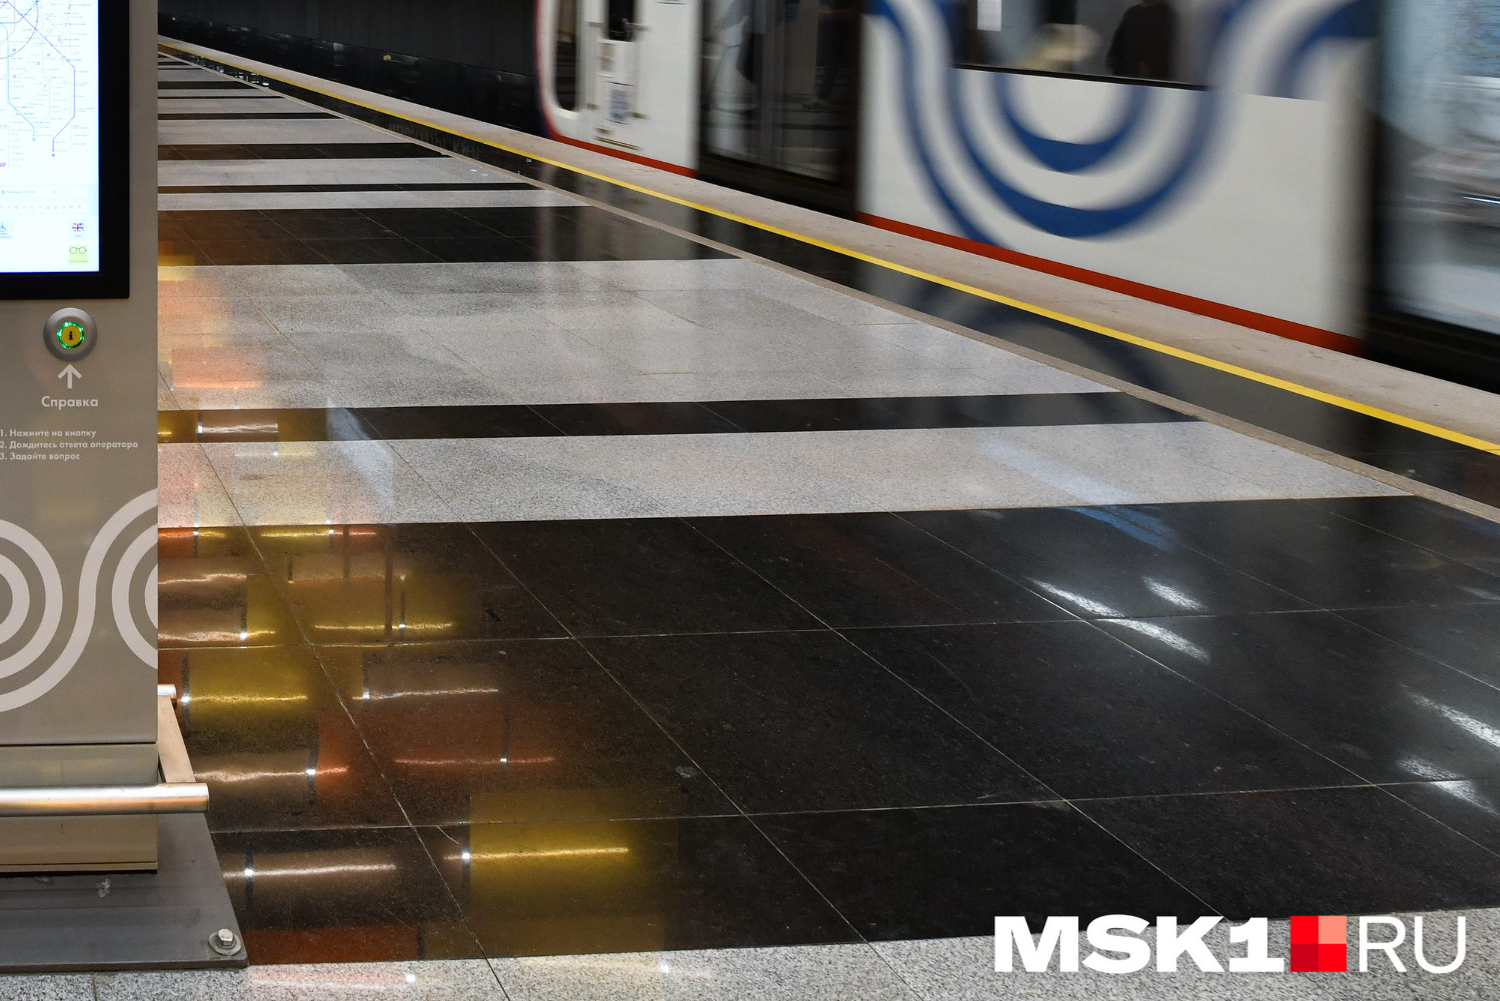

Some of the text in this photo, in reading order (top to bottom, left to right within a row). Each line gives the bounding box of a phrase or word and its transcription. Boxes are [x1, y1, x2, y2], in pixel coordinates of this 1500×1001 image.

[41, 396, 99, 410] Справка
[0, 429, 97, 440] 1. Нажмите на кнопку
[0, 441, 139, 450] 2. Дождитесь ответа оператора
[0, 452, 80, 462] 3. Задайте вопрос
